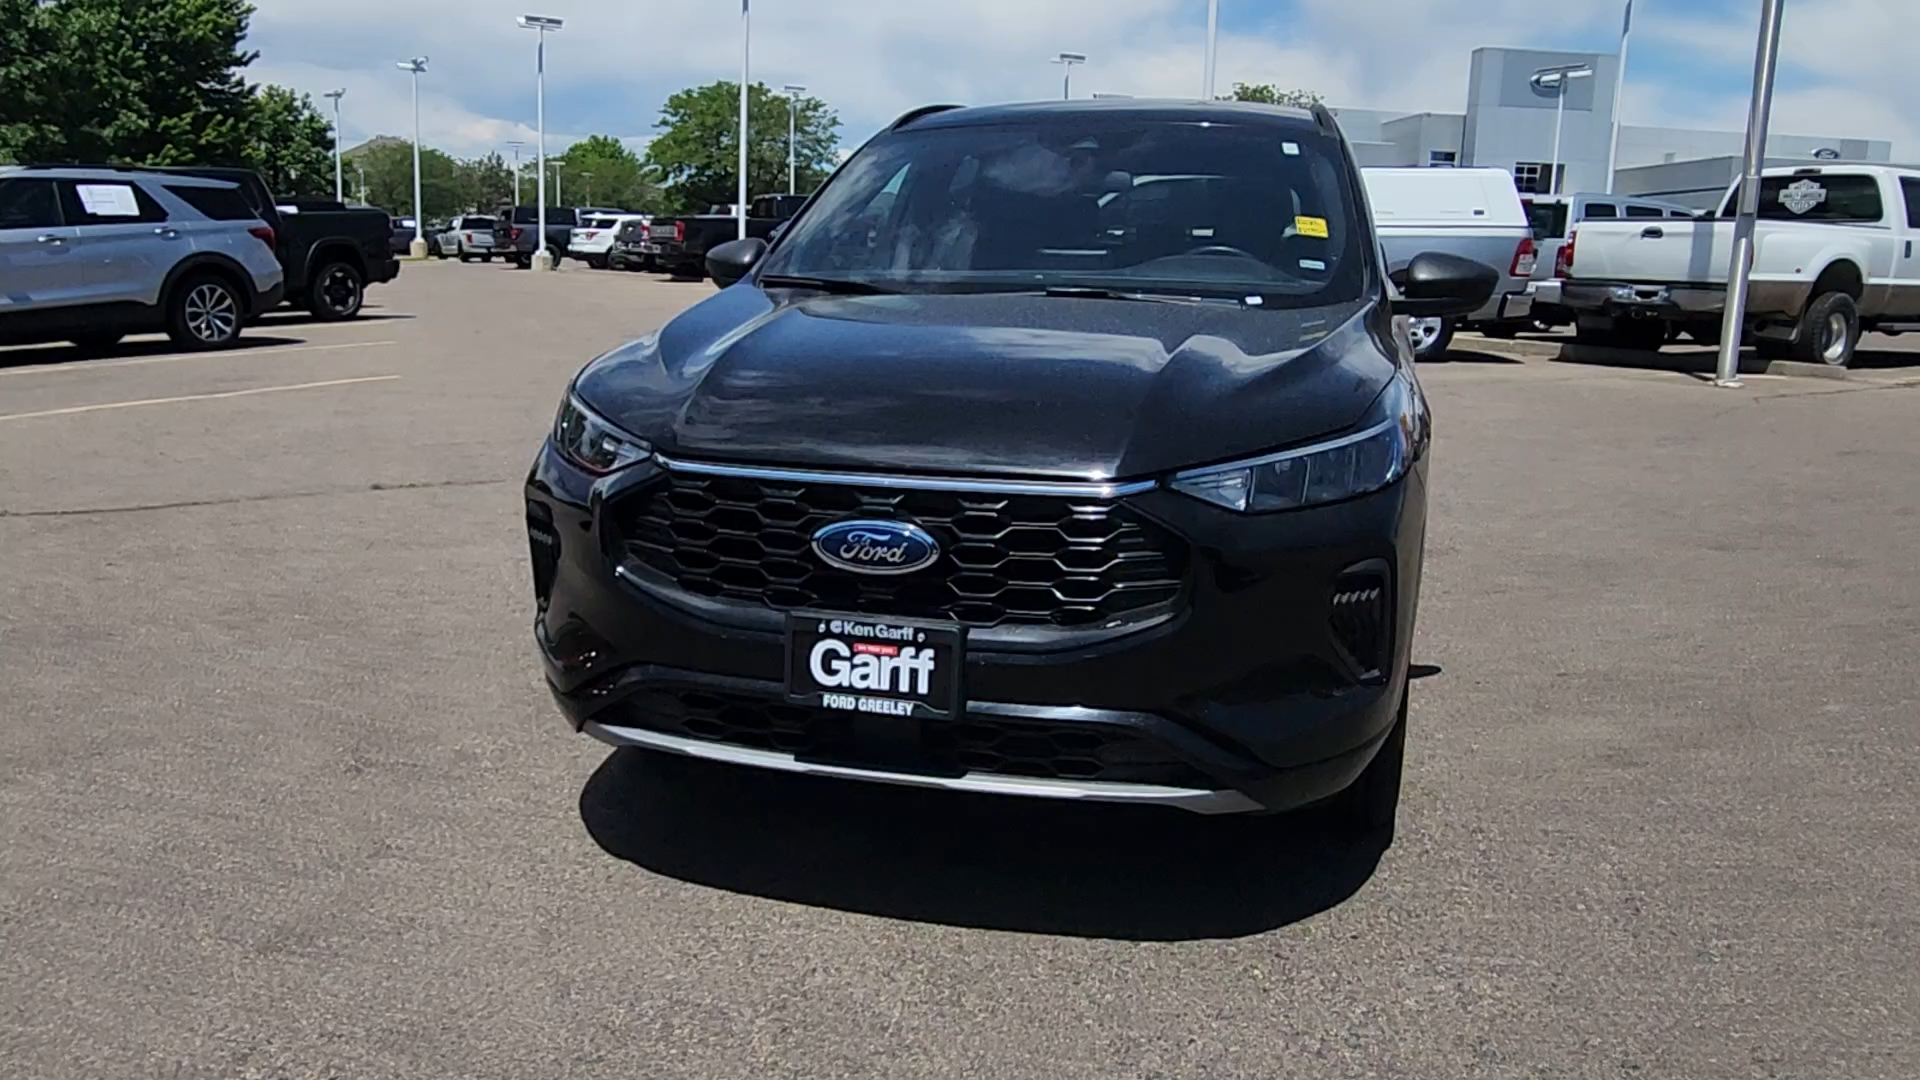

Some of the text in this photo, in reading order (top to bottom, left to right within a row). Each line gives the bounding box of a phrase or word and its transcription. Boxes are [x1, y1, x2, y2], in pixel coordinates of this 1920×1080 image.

[840, 531, 907, 563] Ford
[843, 621, 914, 640] Ken Garff
[810, 639, 935, 694] Garff
[823, 694, 914, 716] FORD GREELEY
